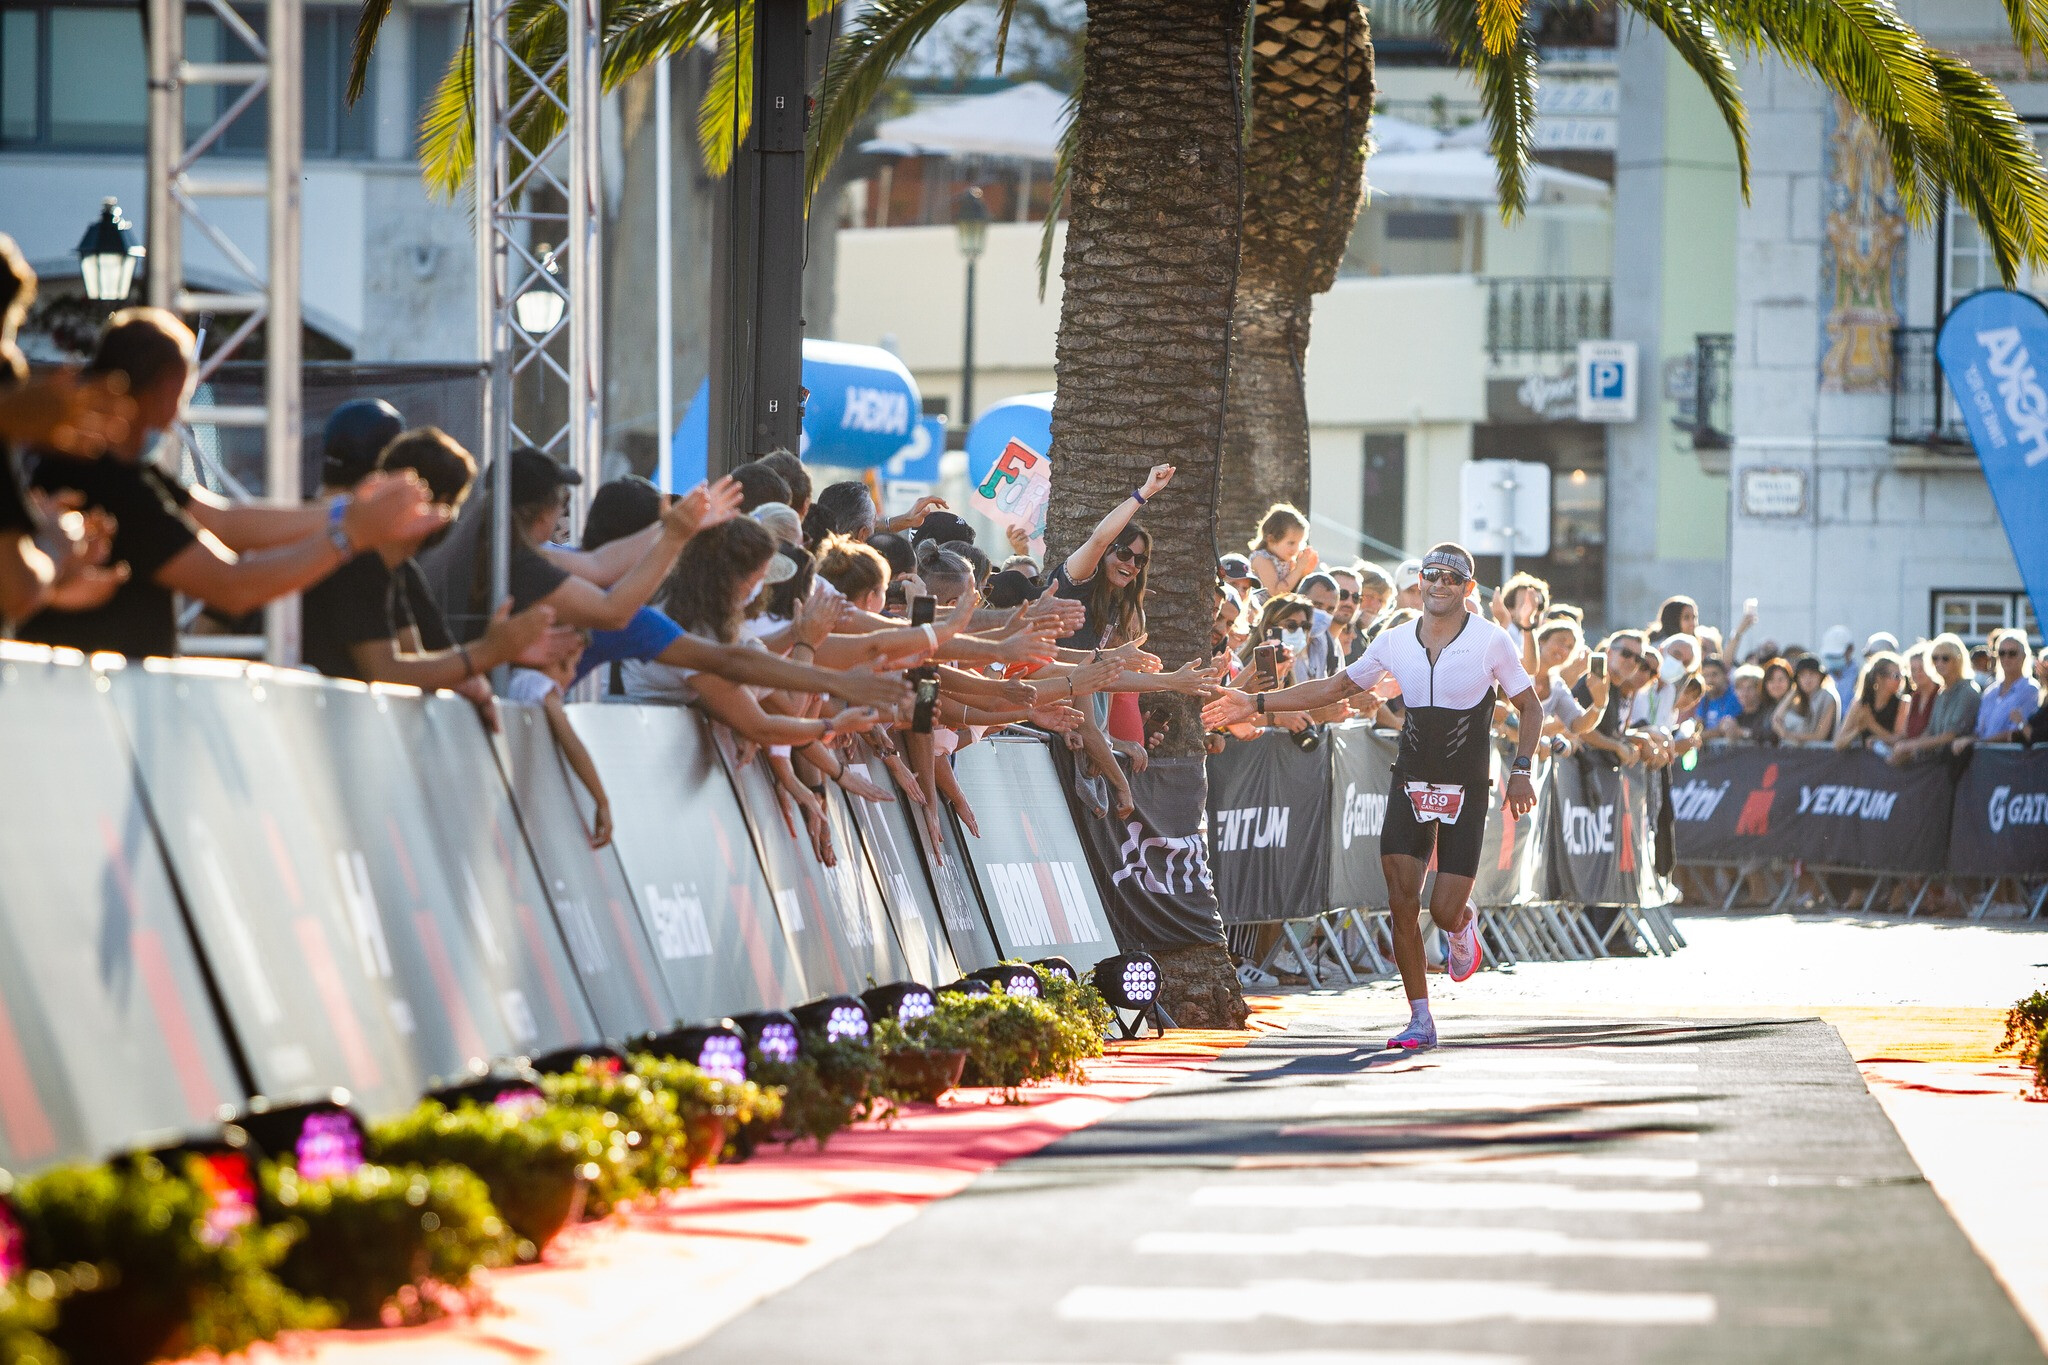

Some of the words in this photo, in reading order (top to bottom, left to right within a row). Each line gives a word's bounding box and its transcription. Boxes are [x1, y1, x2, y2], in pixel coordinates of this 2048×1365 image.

[1594, 362, 1621, 399] P
[841, 386, 909, 435] HOKA
[1354, 793, 1389, 837] GATOR
[1420, 793, 1449, 807] 169
[1420, 804, 1443, 812] CARLOS
[986, 861, 1101, 947] IRONMAN
